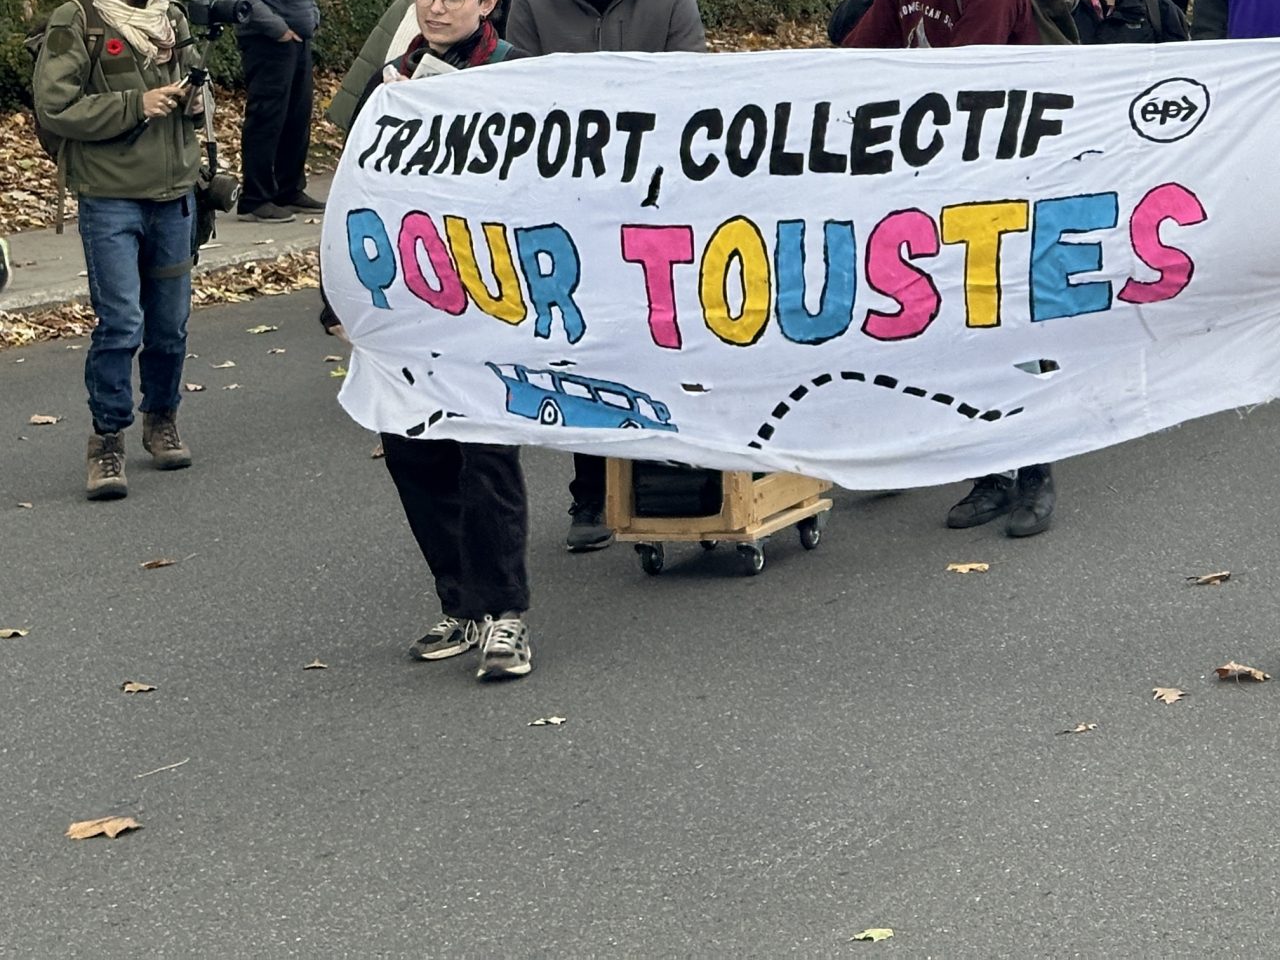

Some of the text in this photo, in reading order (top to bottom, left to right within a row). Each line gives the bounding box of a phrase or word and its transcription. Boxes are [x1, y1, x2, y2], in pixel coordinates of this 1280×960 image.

[358, 90, 1074, 182] TRANSPORT COLLECTIF
[346, 182, 1208, 350] POUR TOUSTES
